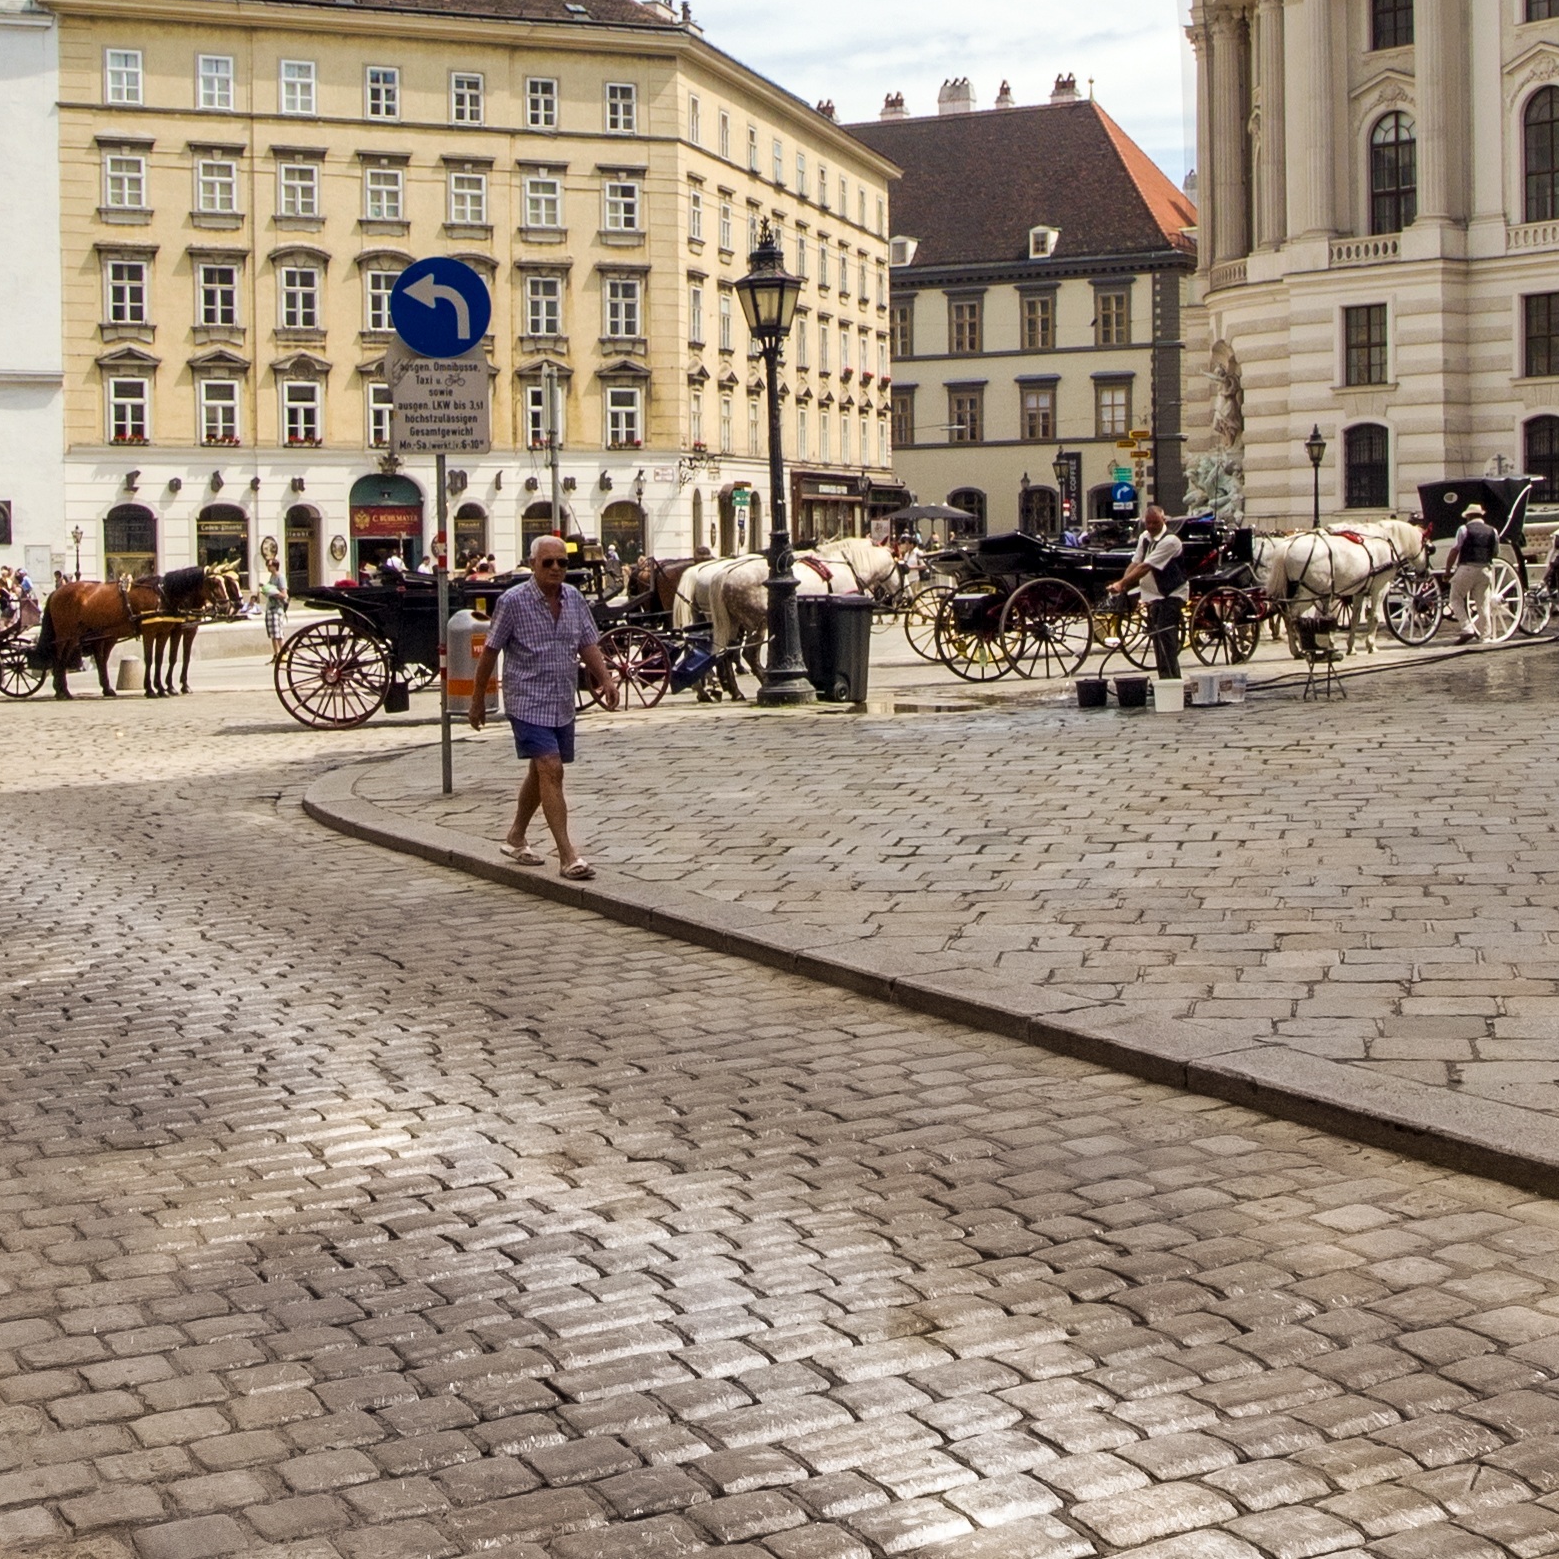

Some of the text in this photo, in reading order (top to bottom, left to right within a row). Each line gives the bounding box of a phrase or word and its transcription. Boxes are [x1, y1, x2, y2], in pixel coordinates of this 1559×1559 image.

[434, 362, 481, 372] Omnibusse,
[416, 375, 433, 385] Taxi
[429, 387, 453, 396] sowie
[398, 402, 430, 412] ausgen.
[432, 401, 451, 410] LKW
[454, 401, 466, 410] bis
[405, 413, 478, 425] höchstzulässigen
[410, 426, 473, 438] Gesamtgewicht
